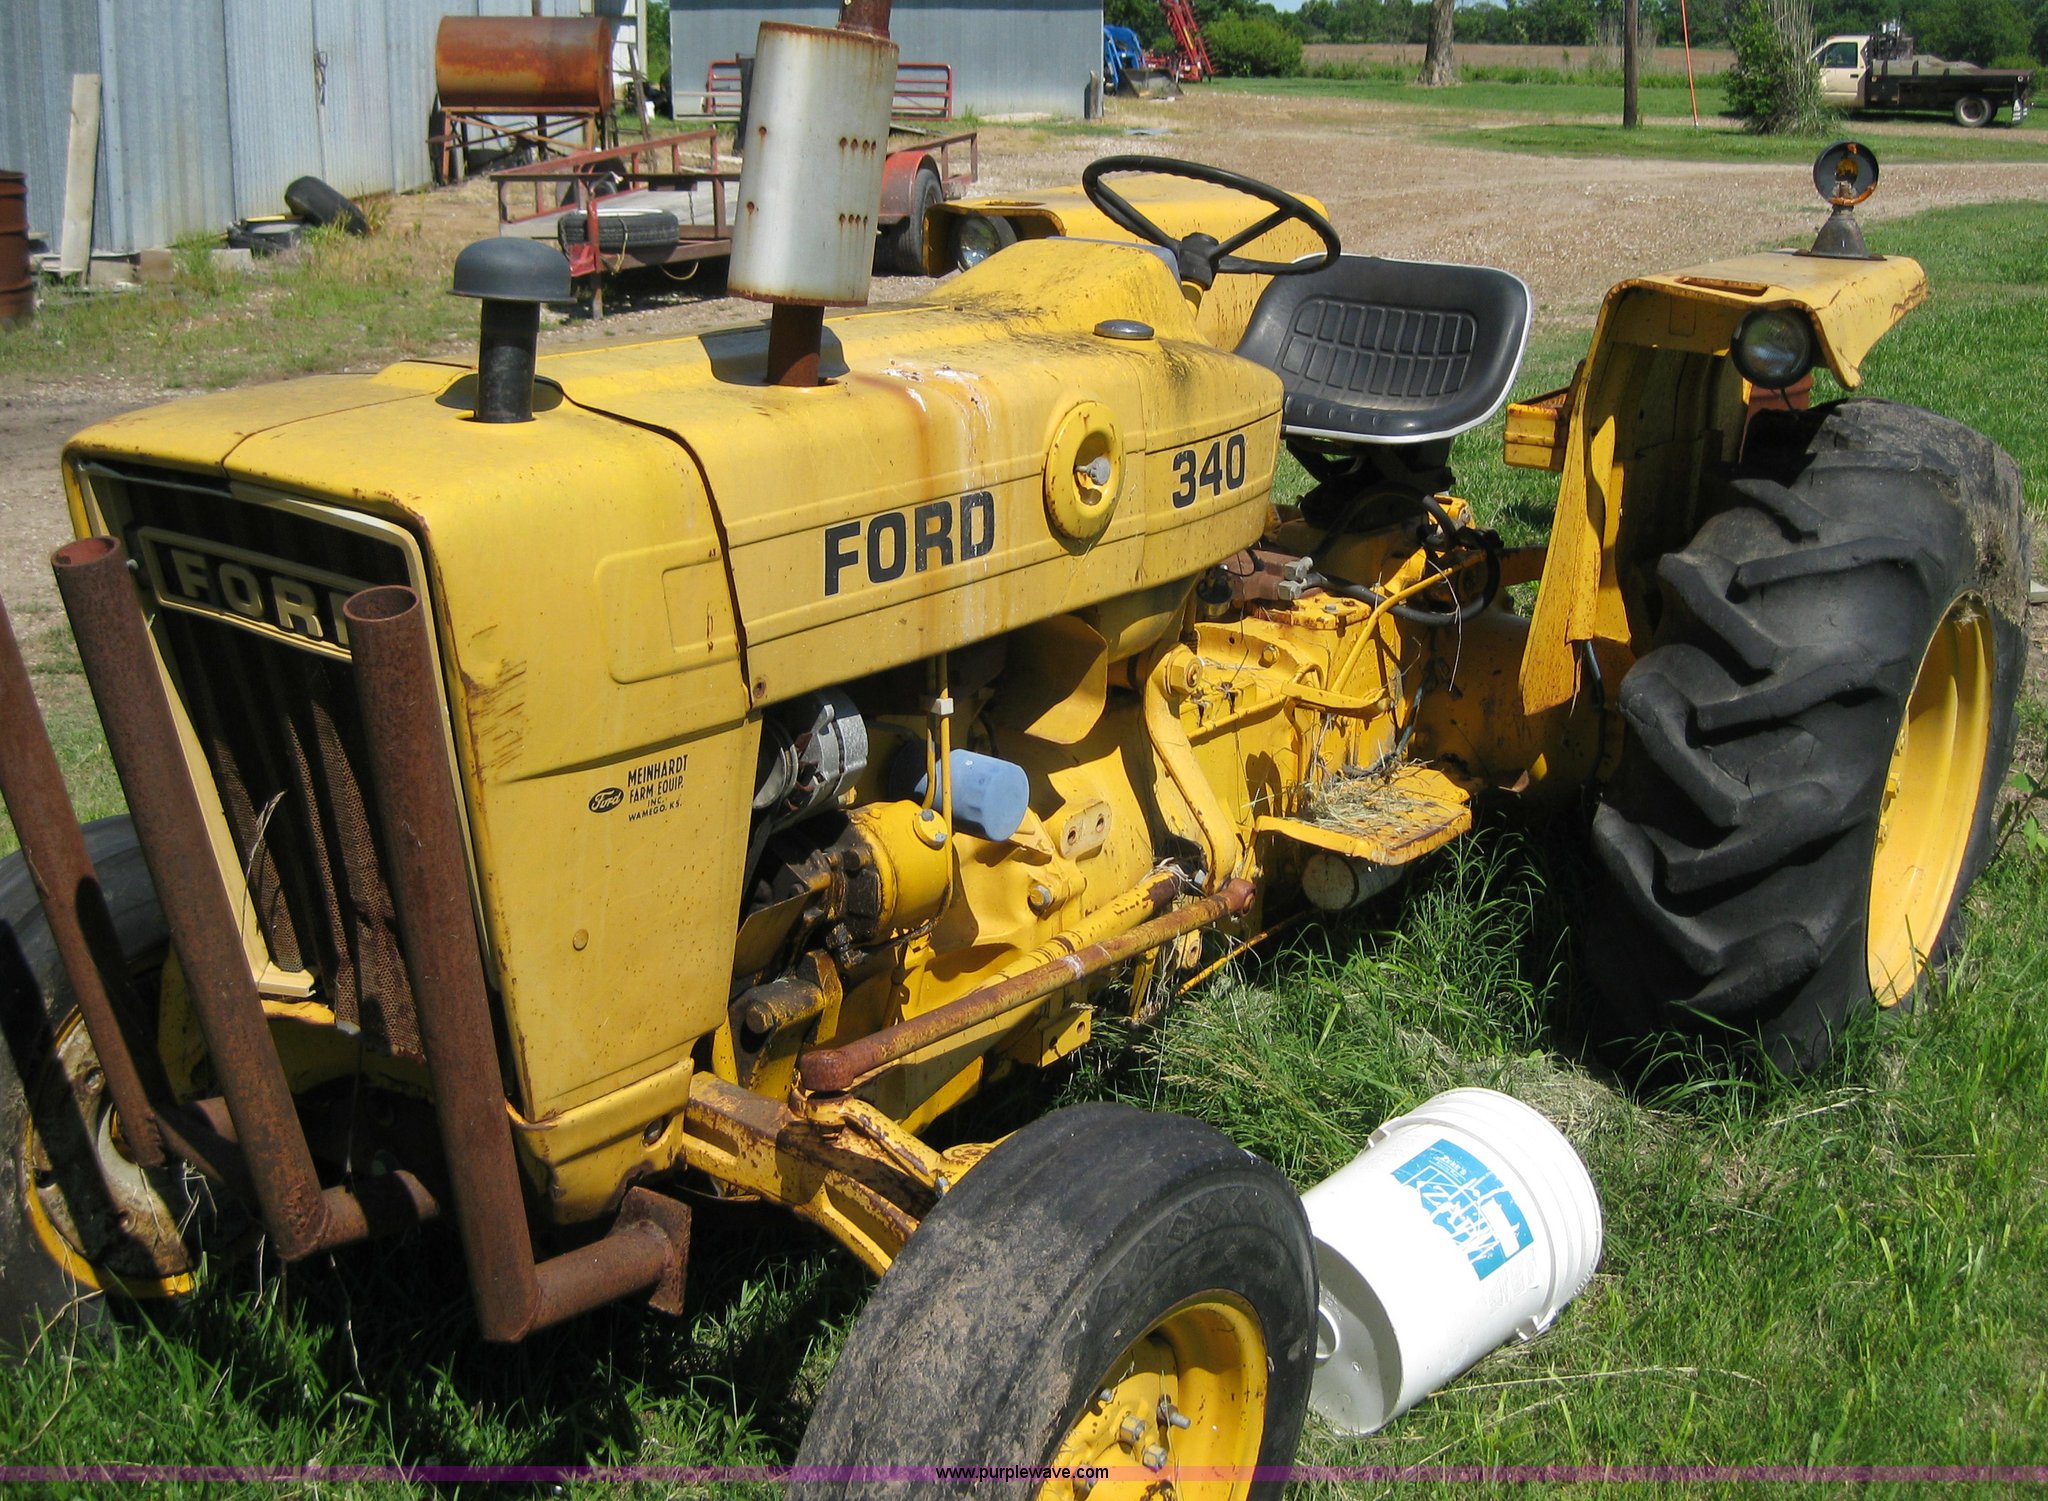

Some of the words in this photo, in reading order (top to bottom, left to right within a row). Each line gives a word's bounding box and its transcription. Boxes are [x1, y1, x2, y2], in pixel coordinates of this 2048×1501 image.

[1172, 433, 1246, 509] 340
[824, 490, 995, 597] FORD
[627, 754, 689, 787] MEINHARDT
[590, 788, 623, 811] Ford
[629, 786, 654, 804] FARM
[657, 775, 684, 798] EQUIP.
